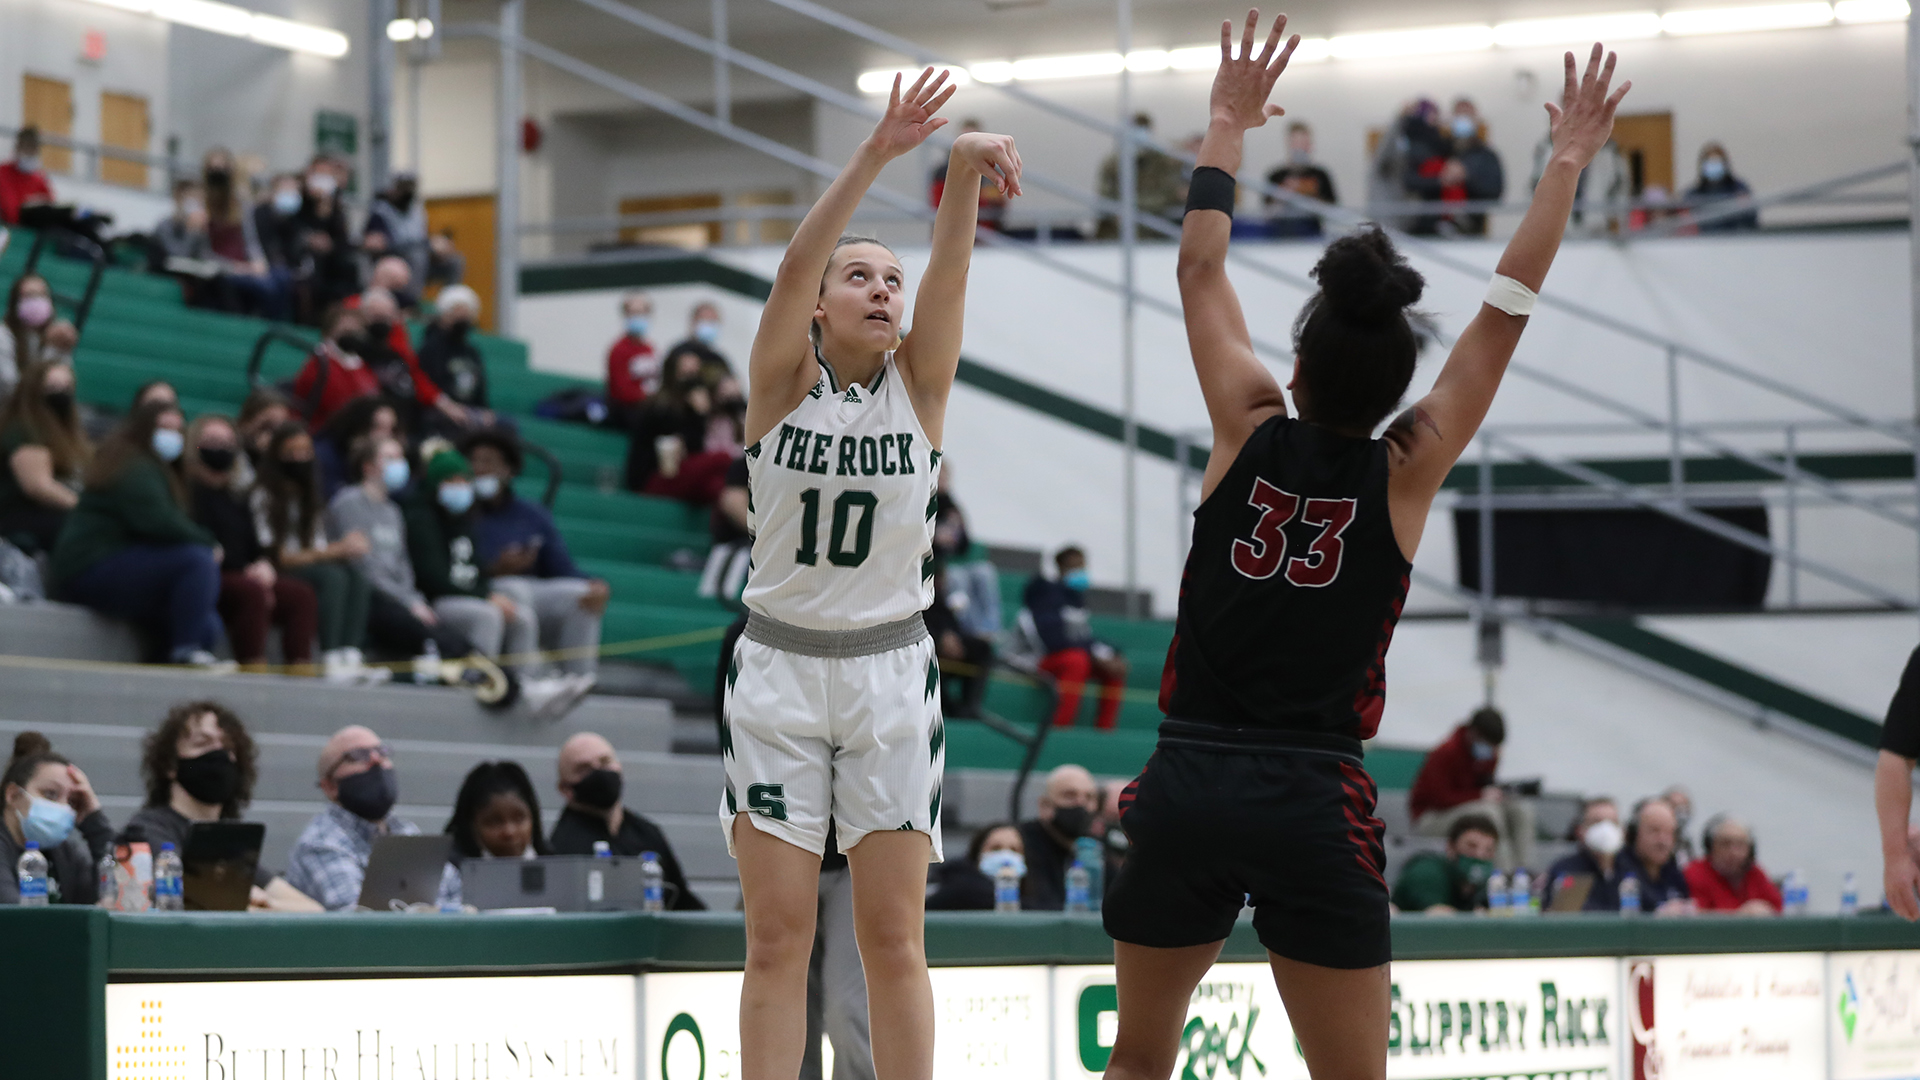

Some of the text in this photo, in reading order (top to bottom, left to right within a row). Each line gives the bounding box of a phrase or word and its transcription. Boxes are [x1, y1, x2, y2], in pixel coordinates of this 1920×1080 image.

[774, 422, 915, 476] THE ROCK
[795, 487, 879, 568] 10
[1231, 476, 1358, 588] 33
[747, 783, 789, 821] S
[1540, 981, 1609, 1048] ROCK
[202, 1028, 619, 1080] BUTLER HEALTH SYSTEM
